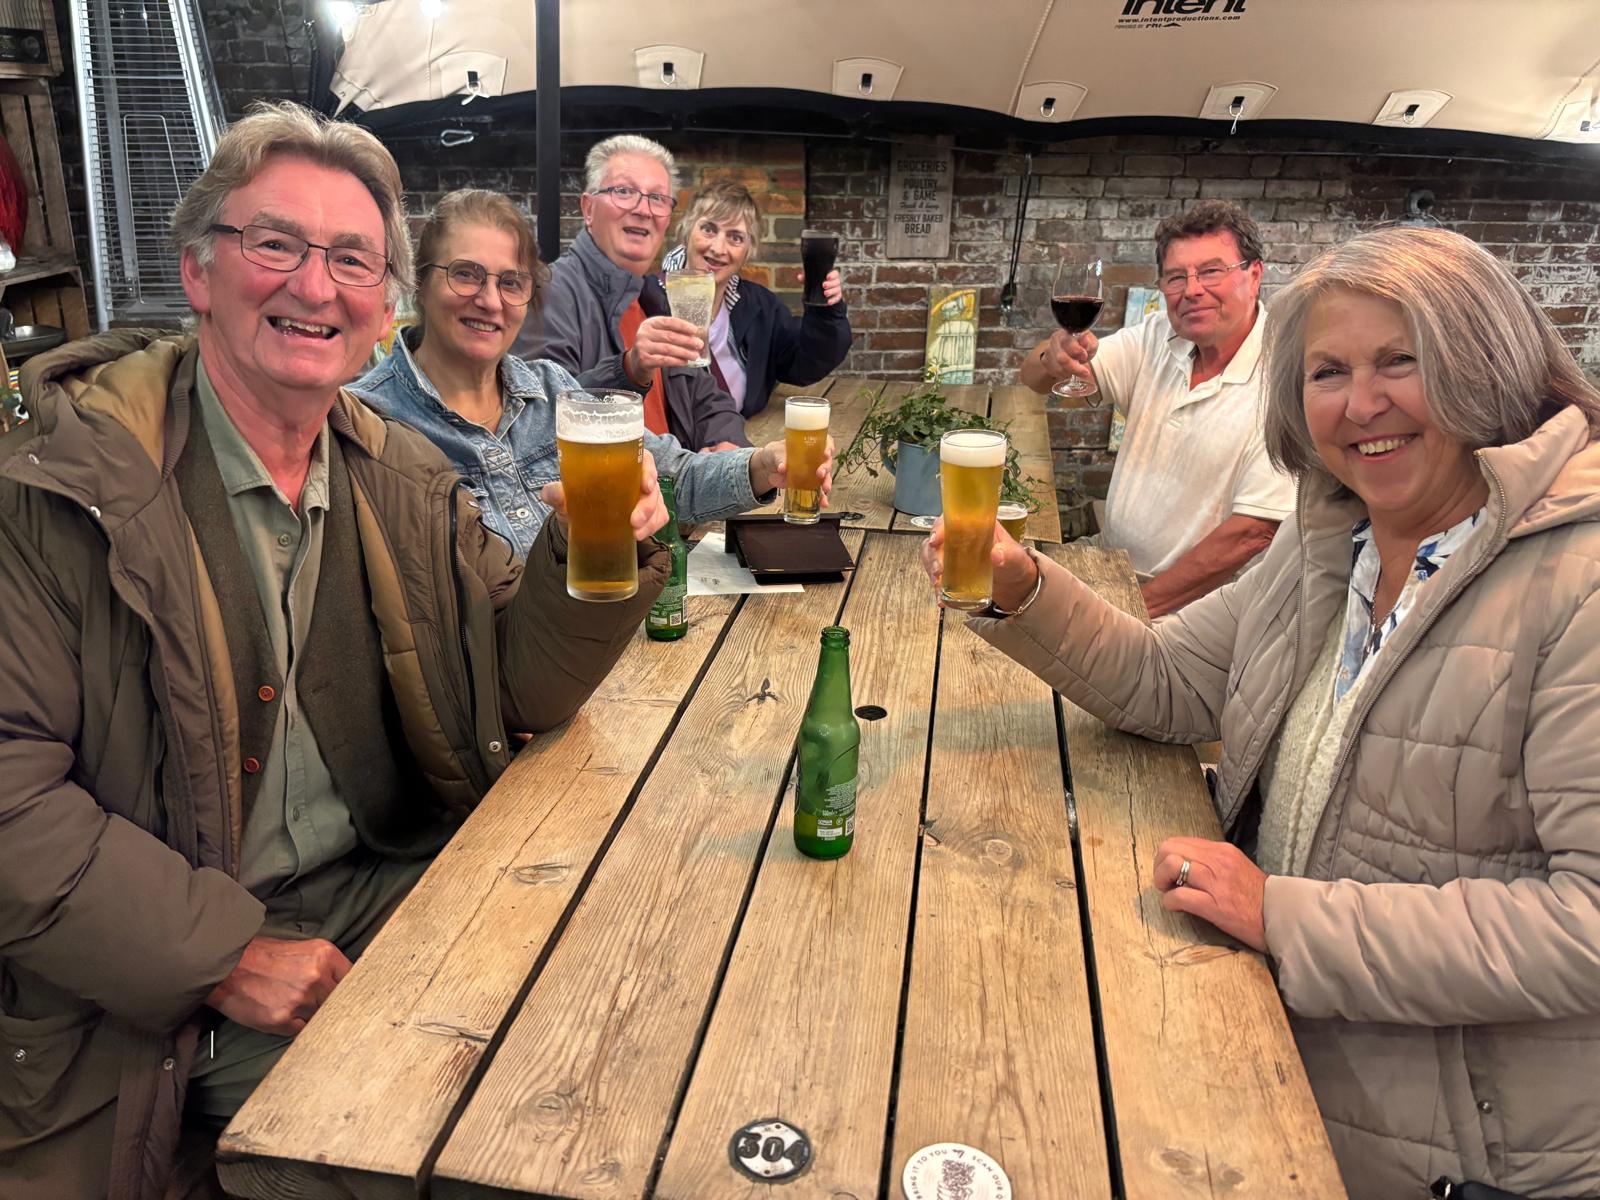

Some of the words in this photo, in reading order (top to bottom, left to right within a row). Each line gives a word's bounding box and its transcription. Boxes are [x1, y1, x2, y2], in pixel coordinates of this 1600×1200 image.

[1118, 15, 1240, 23] www.intentproductions.com
[897, 160, 947, 172] GROCERIES
[903, 178, 938, 189] POULTRY
[903, 191, 909, 200] &
[914, 190, 937, 200] GAME
[894, 214, 922, 223] FRESHLY
[923, 214, 943, 223] BAKED
[904, 223, 931, 234] BREAD
[930, 1149, 948, 1157] YOU
[917, 1156, 928, 1165] TO
[912, 1166, 919, 1174] IT
[972, 1155, 994, 1173] SCAN
[992, 1174, 1004, 1191] OUR
[910, 1176, 922, 1200] BRING
